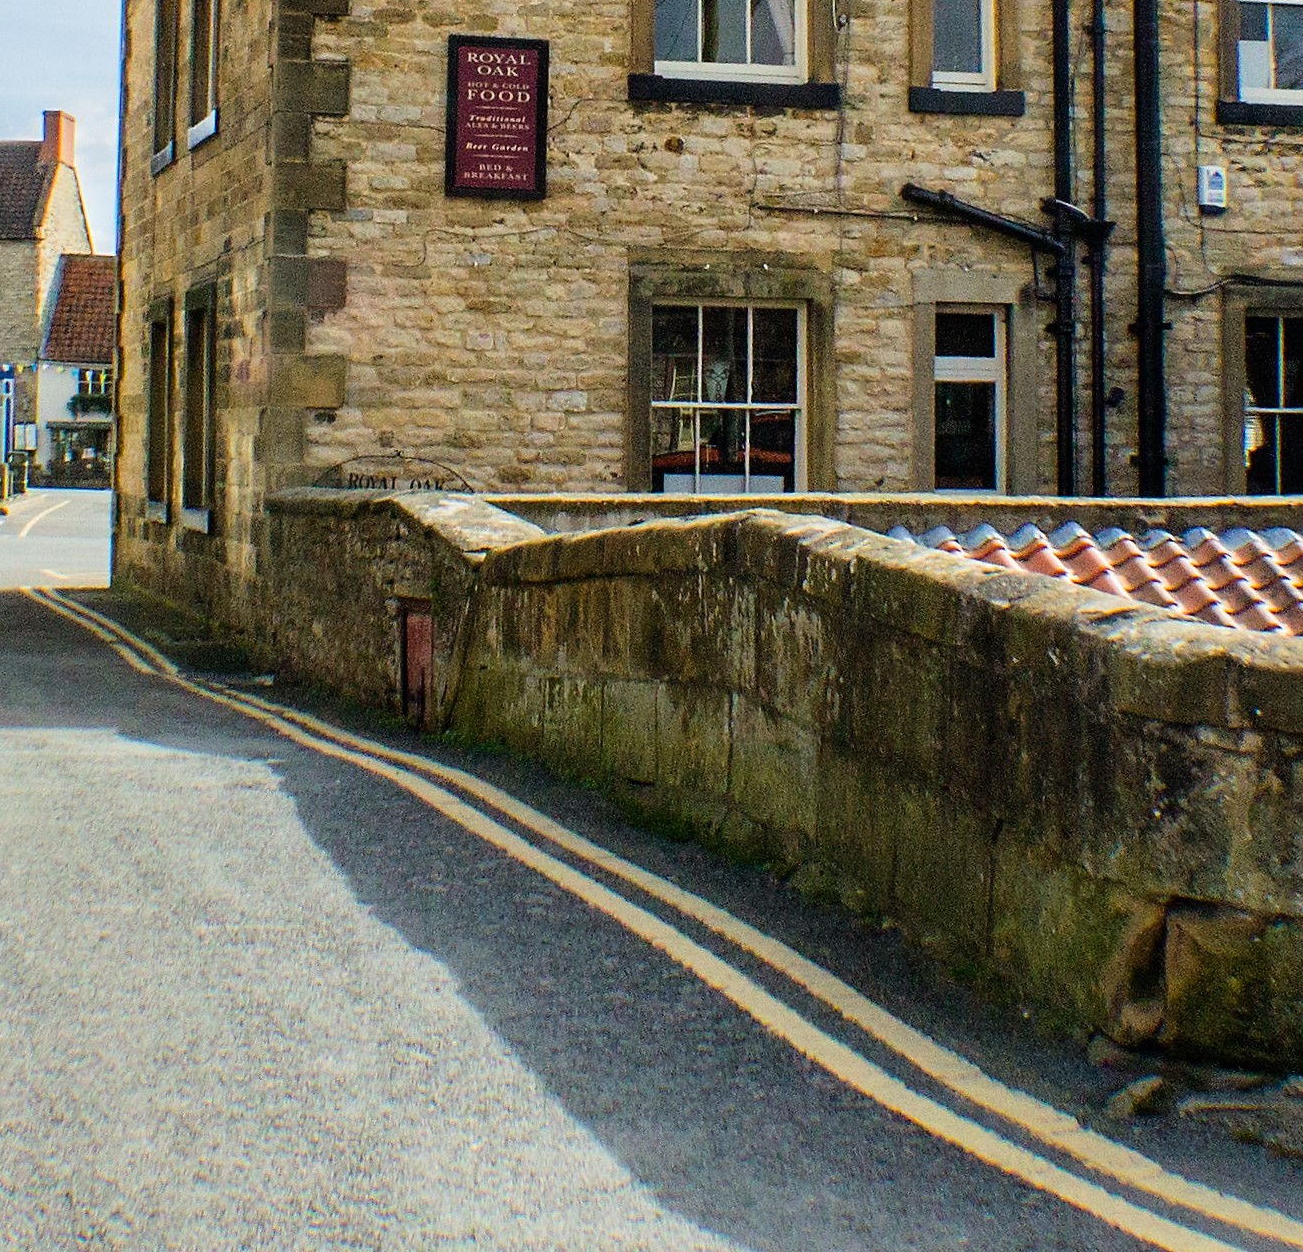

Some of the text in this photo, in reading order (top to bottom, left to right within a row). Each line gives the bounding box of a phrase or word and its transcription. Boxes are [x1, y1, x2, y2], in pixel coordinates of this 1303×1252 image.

[467, 52, 531, 66] ROYAL
[477, 65, 519, 77] OAK
[467, 89, 531, 103] FOOD
[469, 114, 526, 123] Traditional
[465, 142, 529, 152] Beer Garden
[479, 163, 502, 171] BED
[464, 171, 529, 181] BREAKFAST
[348, 472, 397, 490] ROYAL
